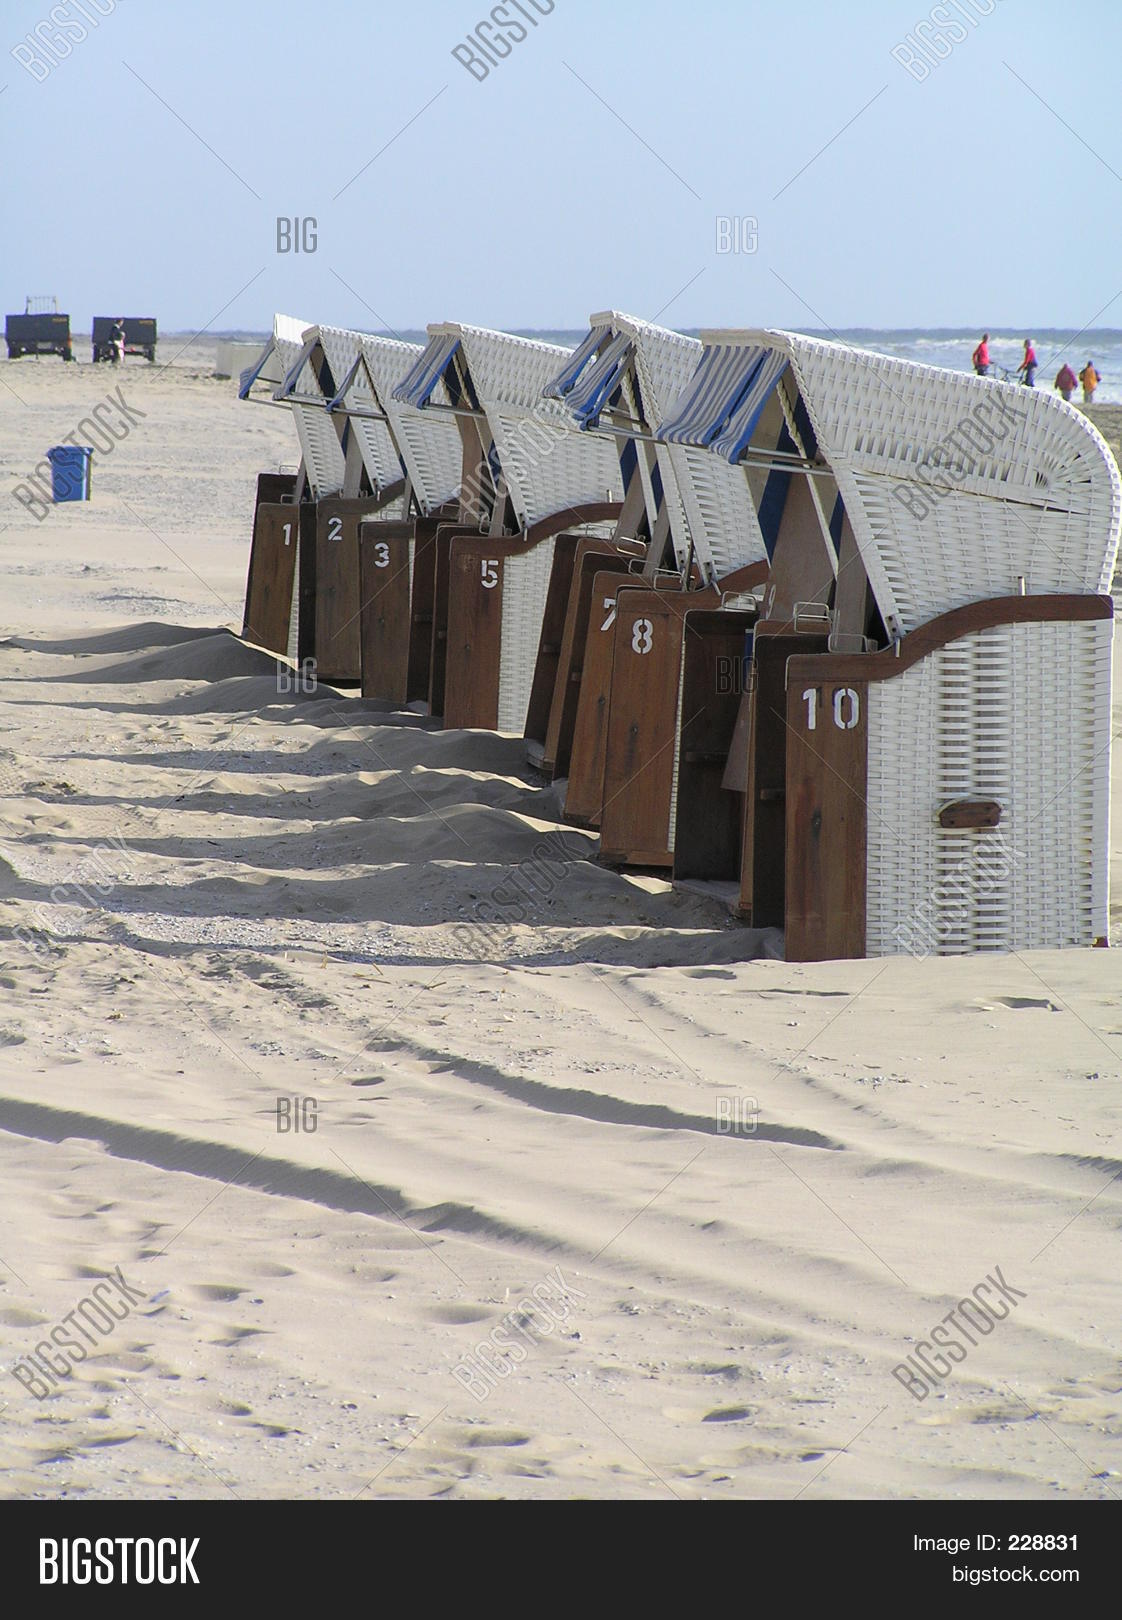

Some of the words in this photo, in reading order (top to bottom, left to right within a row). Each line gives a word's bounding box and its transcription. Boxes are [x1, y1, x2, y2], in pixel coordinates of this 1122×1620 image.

[282, 523, 291, 546] 1
[328, 517, 343, 541] 2
[374, 542, 390, 568] 3
[481, 559, 499, 589] 5
[601, 598, 616, 631] 7
[632, 619, 653, 655] 8
[803, 688, 860, 730] 10
